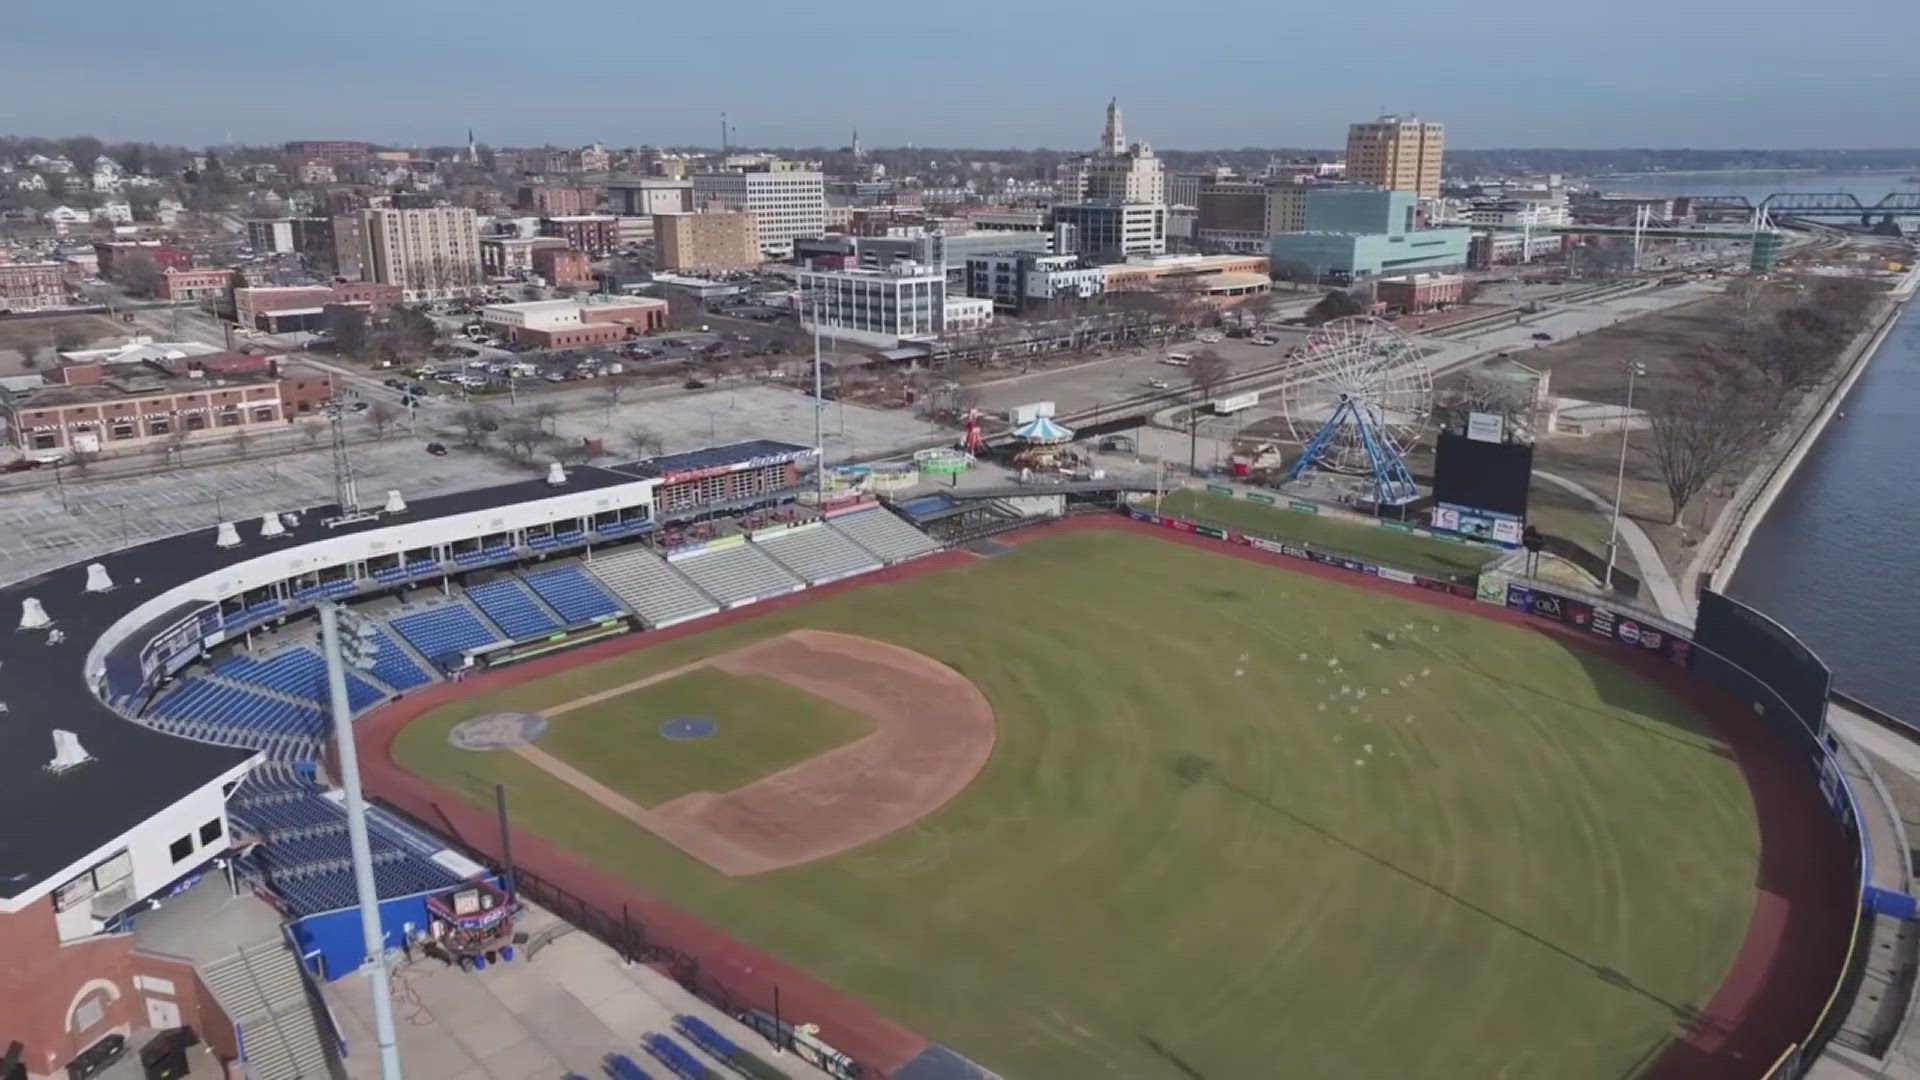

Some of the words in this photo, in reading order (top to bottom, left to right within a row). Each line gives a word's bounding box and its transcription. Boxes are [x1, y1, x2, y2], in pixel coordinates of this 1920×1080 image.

[33, 419, 107, 432] DAVENPORT
[114, 411, 169, 422] PRINTING
[177, 405, 226, 415] COMPANY
